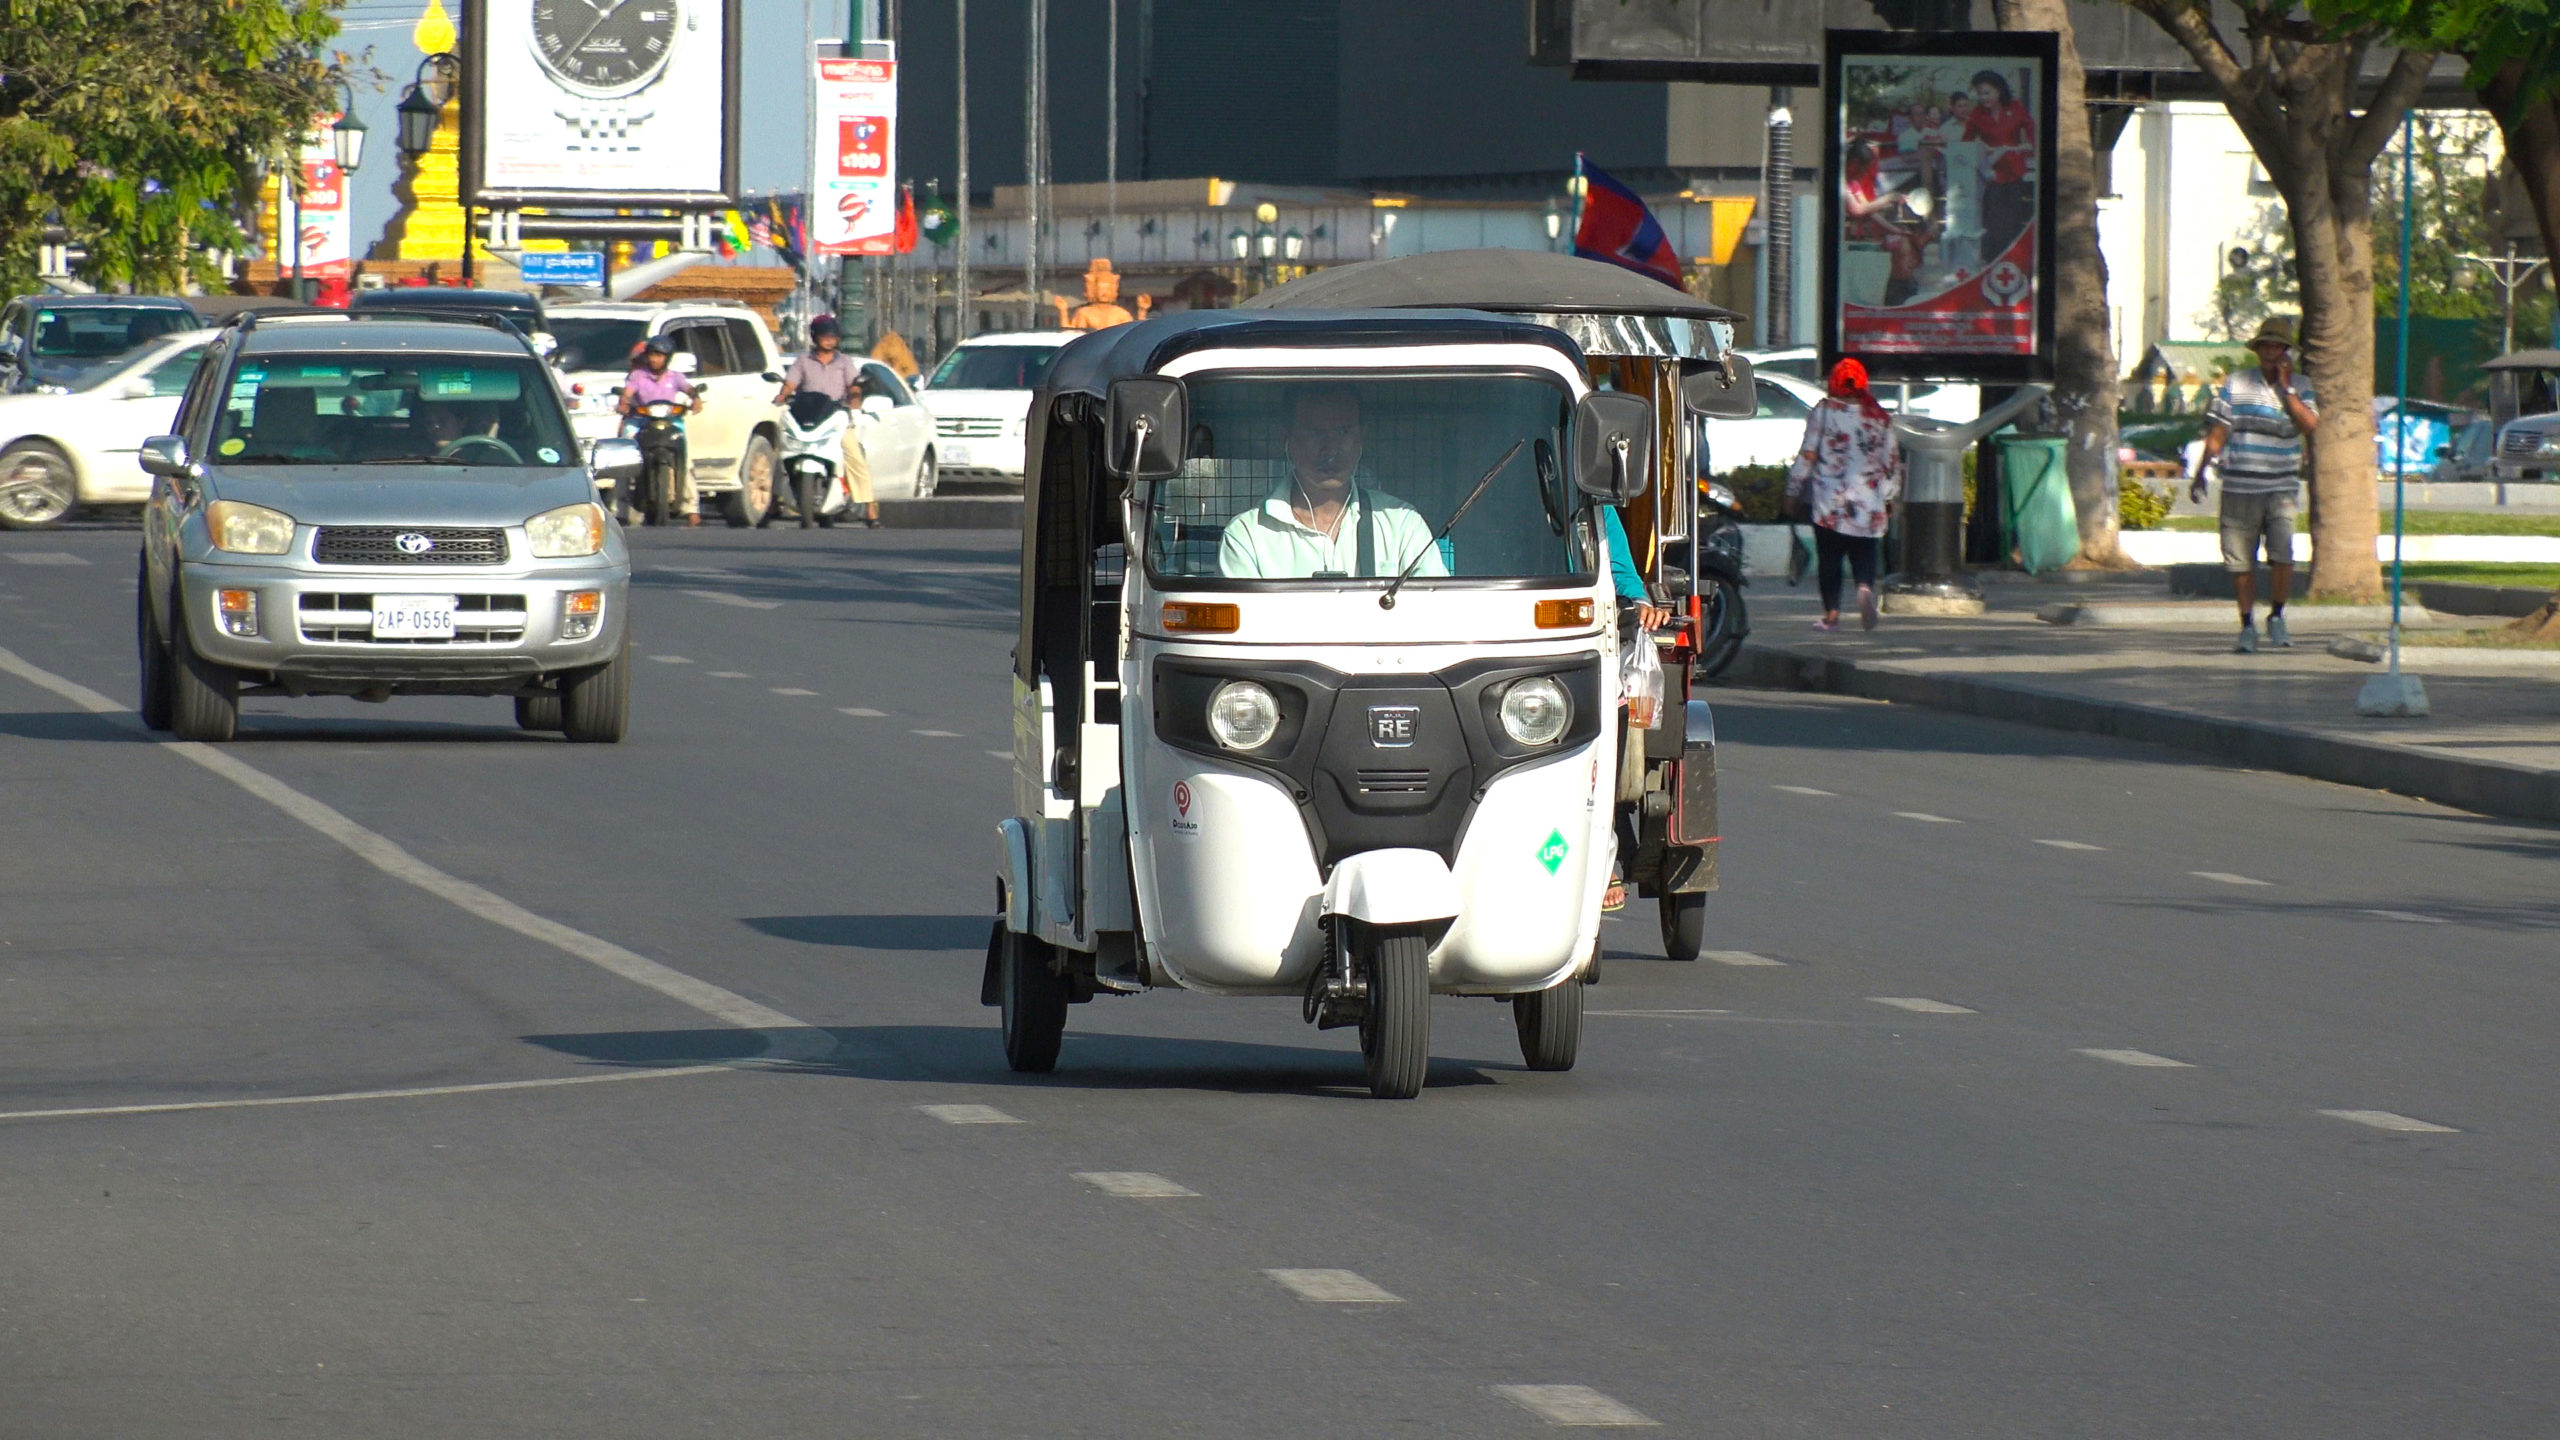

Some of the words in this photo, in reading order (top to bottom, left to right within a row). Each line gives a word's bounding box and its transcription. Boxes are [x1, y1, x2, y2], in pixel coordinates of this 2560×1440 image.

[378, 611, 451, 629] 2AP-0556
[1378, 719, 1411, 738] RE
[1543, 844, 1564, 860] LPG
